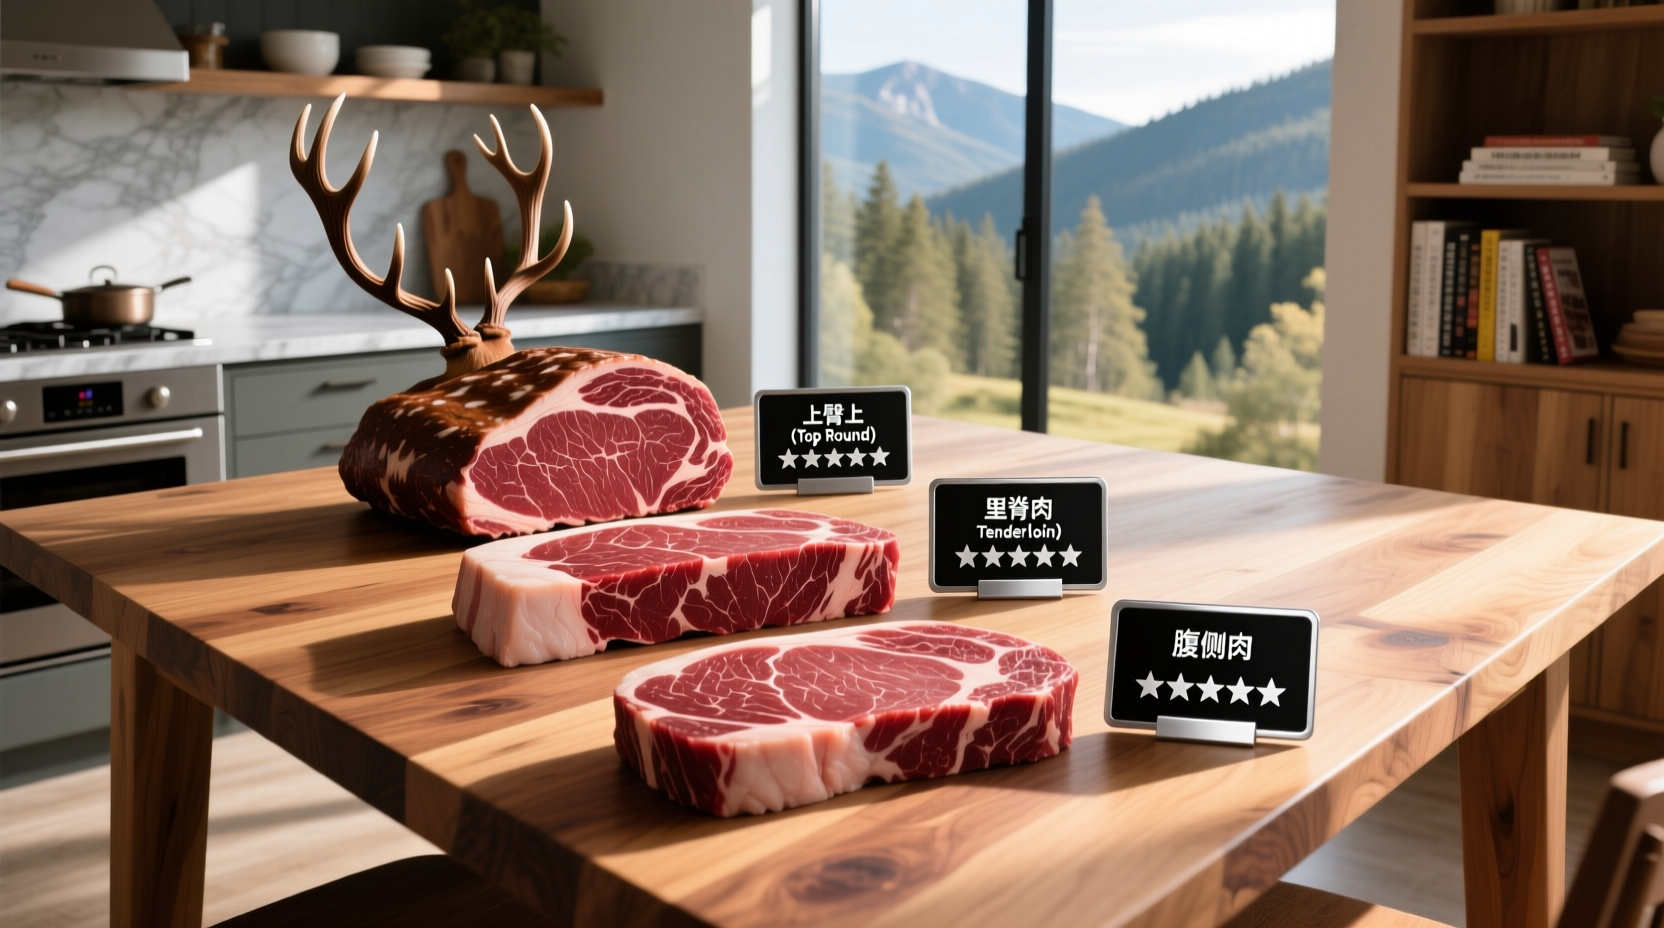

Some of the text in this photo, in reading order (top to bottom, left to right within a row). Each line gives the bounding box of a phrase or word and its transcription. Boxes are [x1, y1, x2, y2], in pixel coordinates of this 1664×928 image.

[791, 426, 876, 447] (Top Round)
[984, 495, 1053, 521] 里脊肉
[976, 523, 1062, 541] Tenderloin)
[1171, 628, 1253, 661] 腹侧肉
